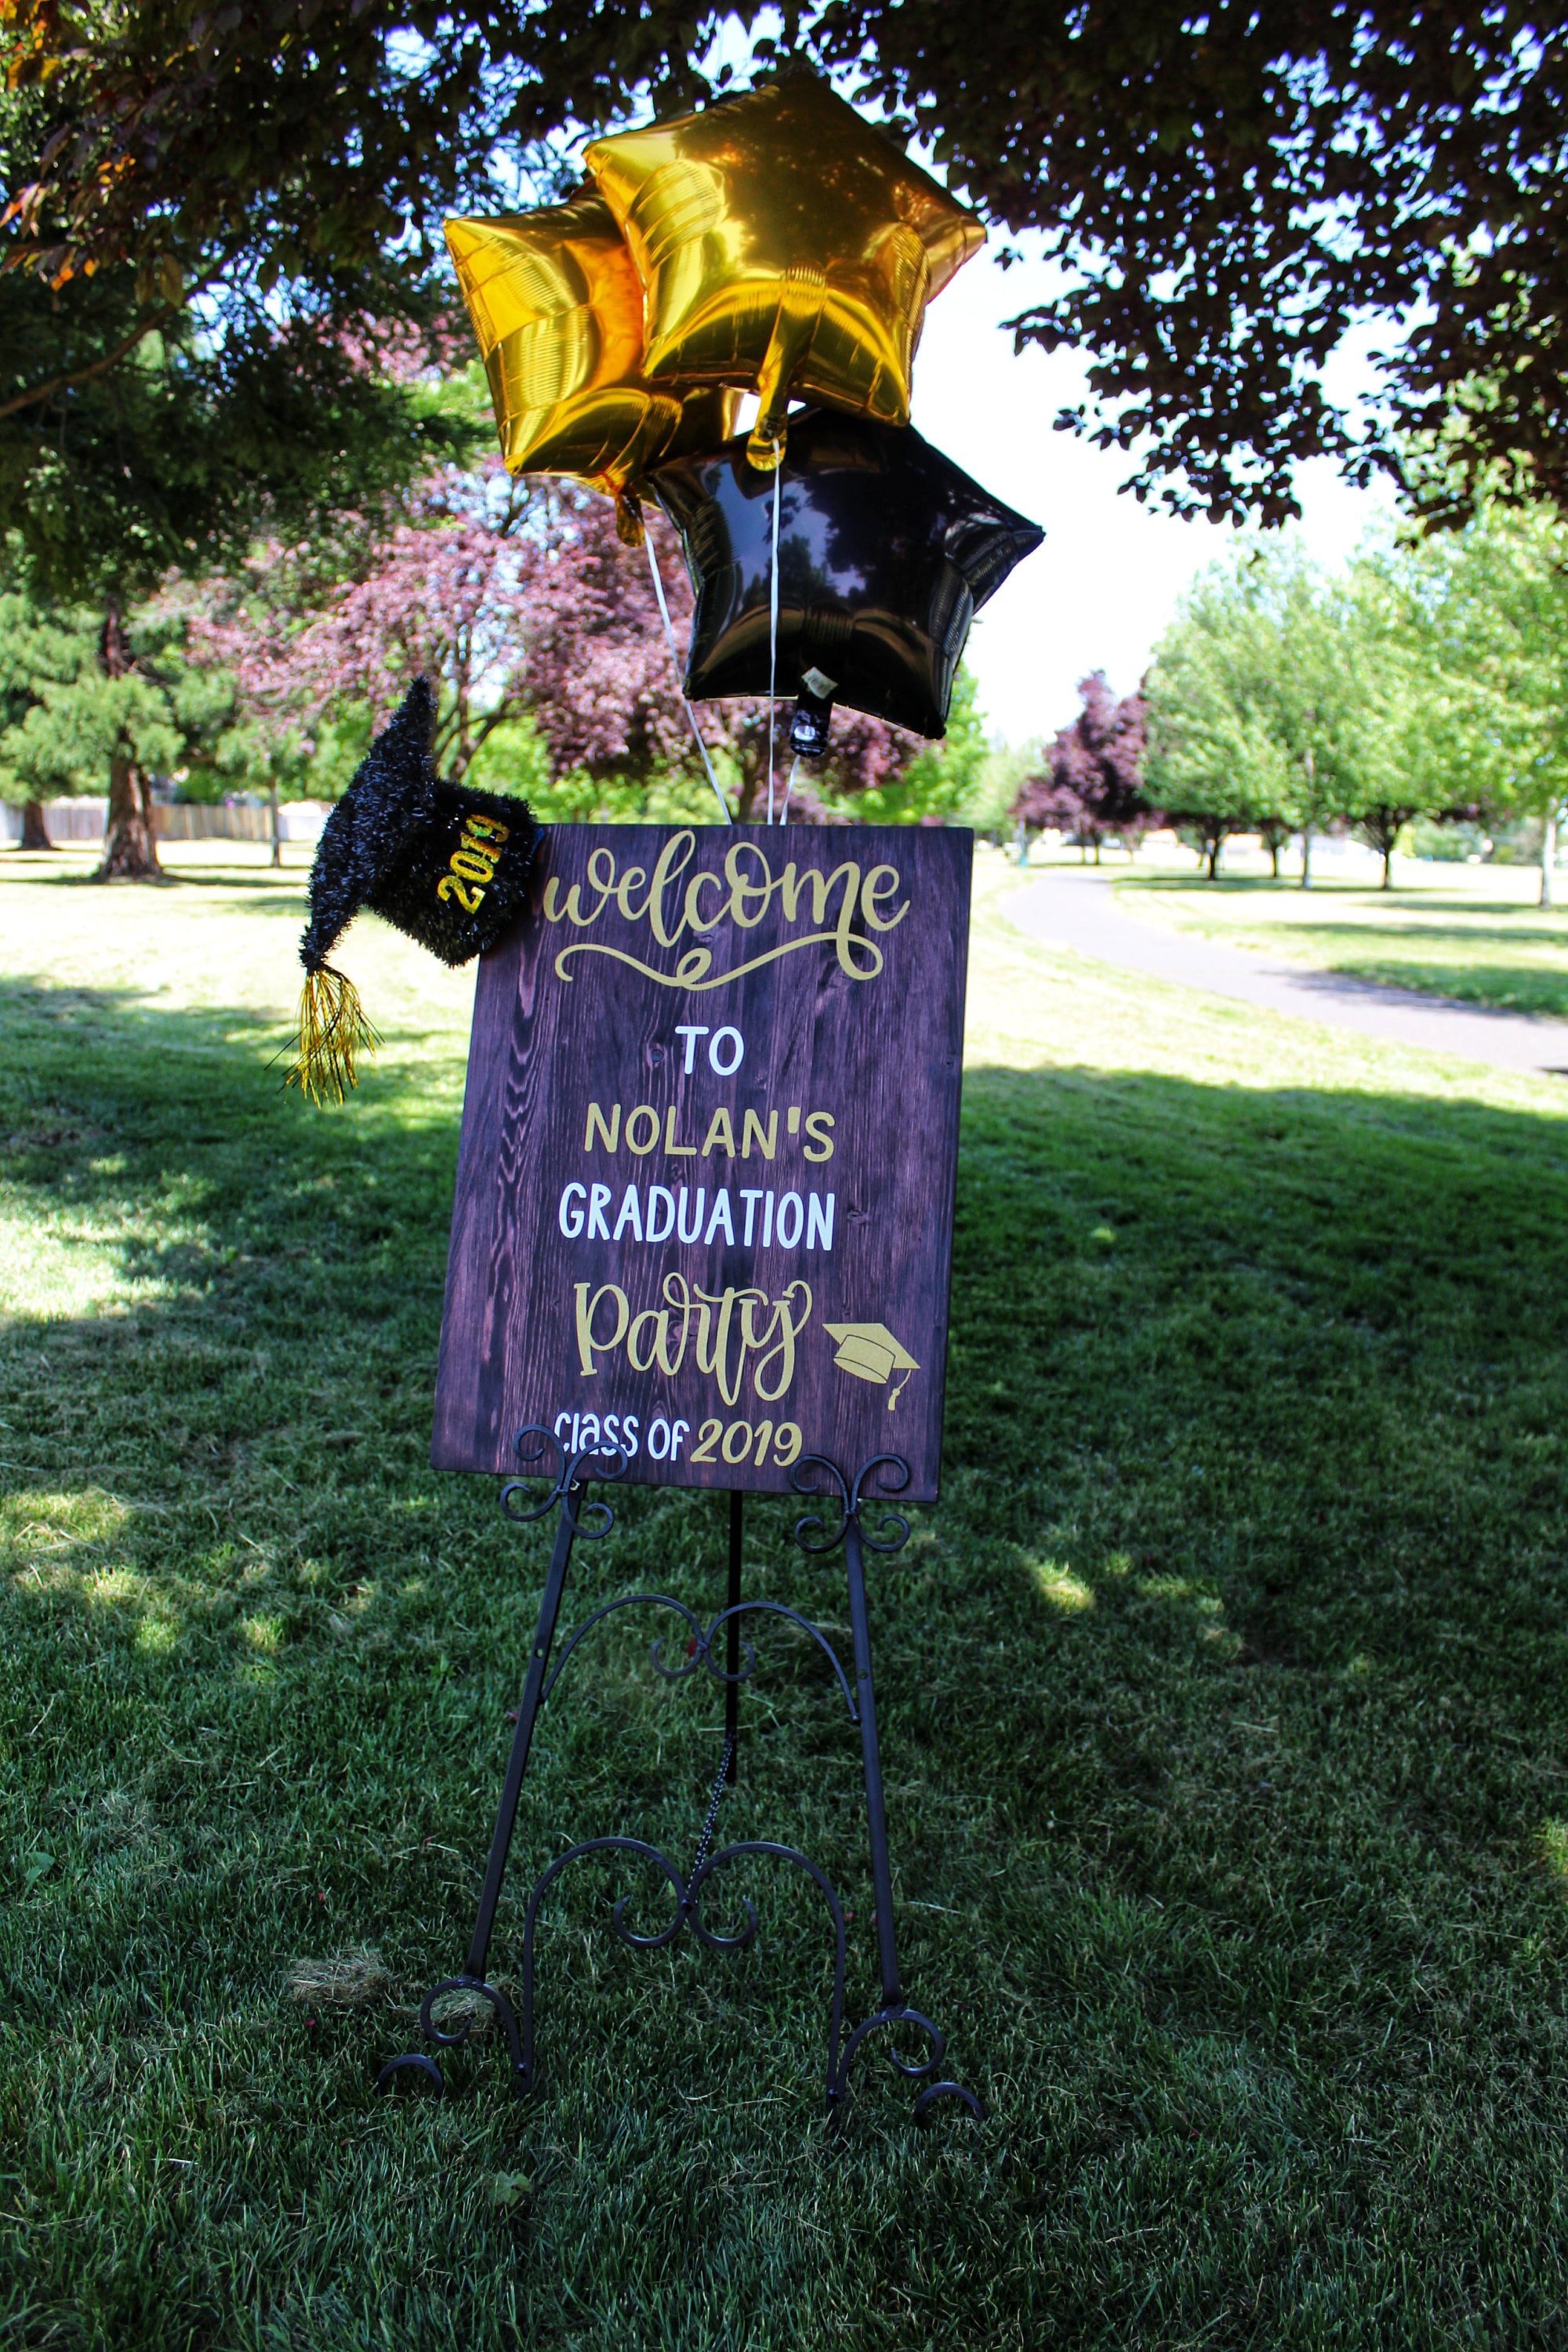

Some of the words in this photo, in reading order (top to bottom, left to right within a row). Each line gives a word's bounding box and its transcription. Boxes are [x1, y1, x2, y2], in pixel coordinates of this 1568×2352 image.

[437, 814, 509, 914] 2019
[543, 829, 910, 991] welcome
[675, 1025, 745, 1076] TO
[584, 1102, 836, 1162] NOLAN'S
[558, 1181, 836, 1251] GRADUATION
[689, 1418, 803, 1467] 2019
